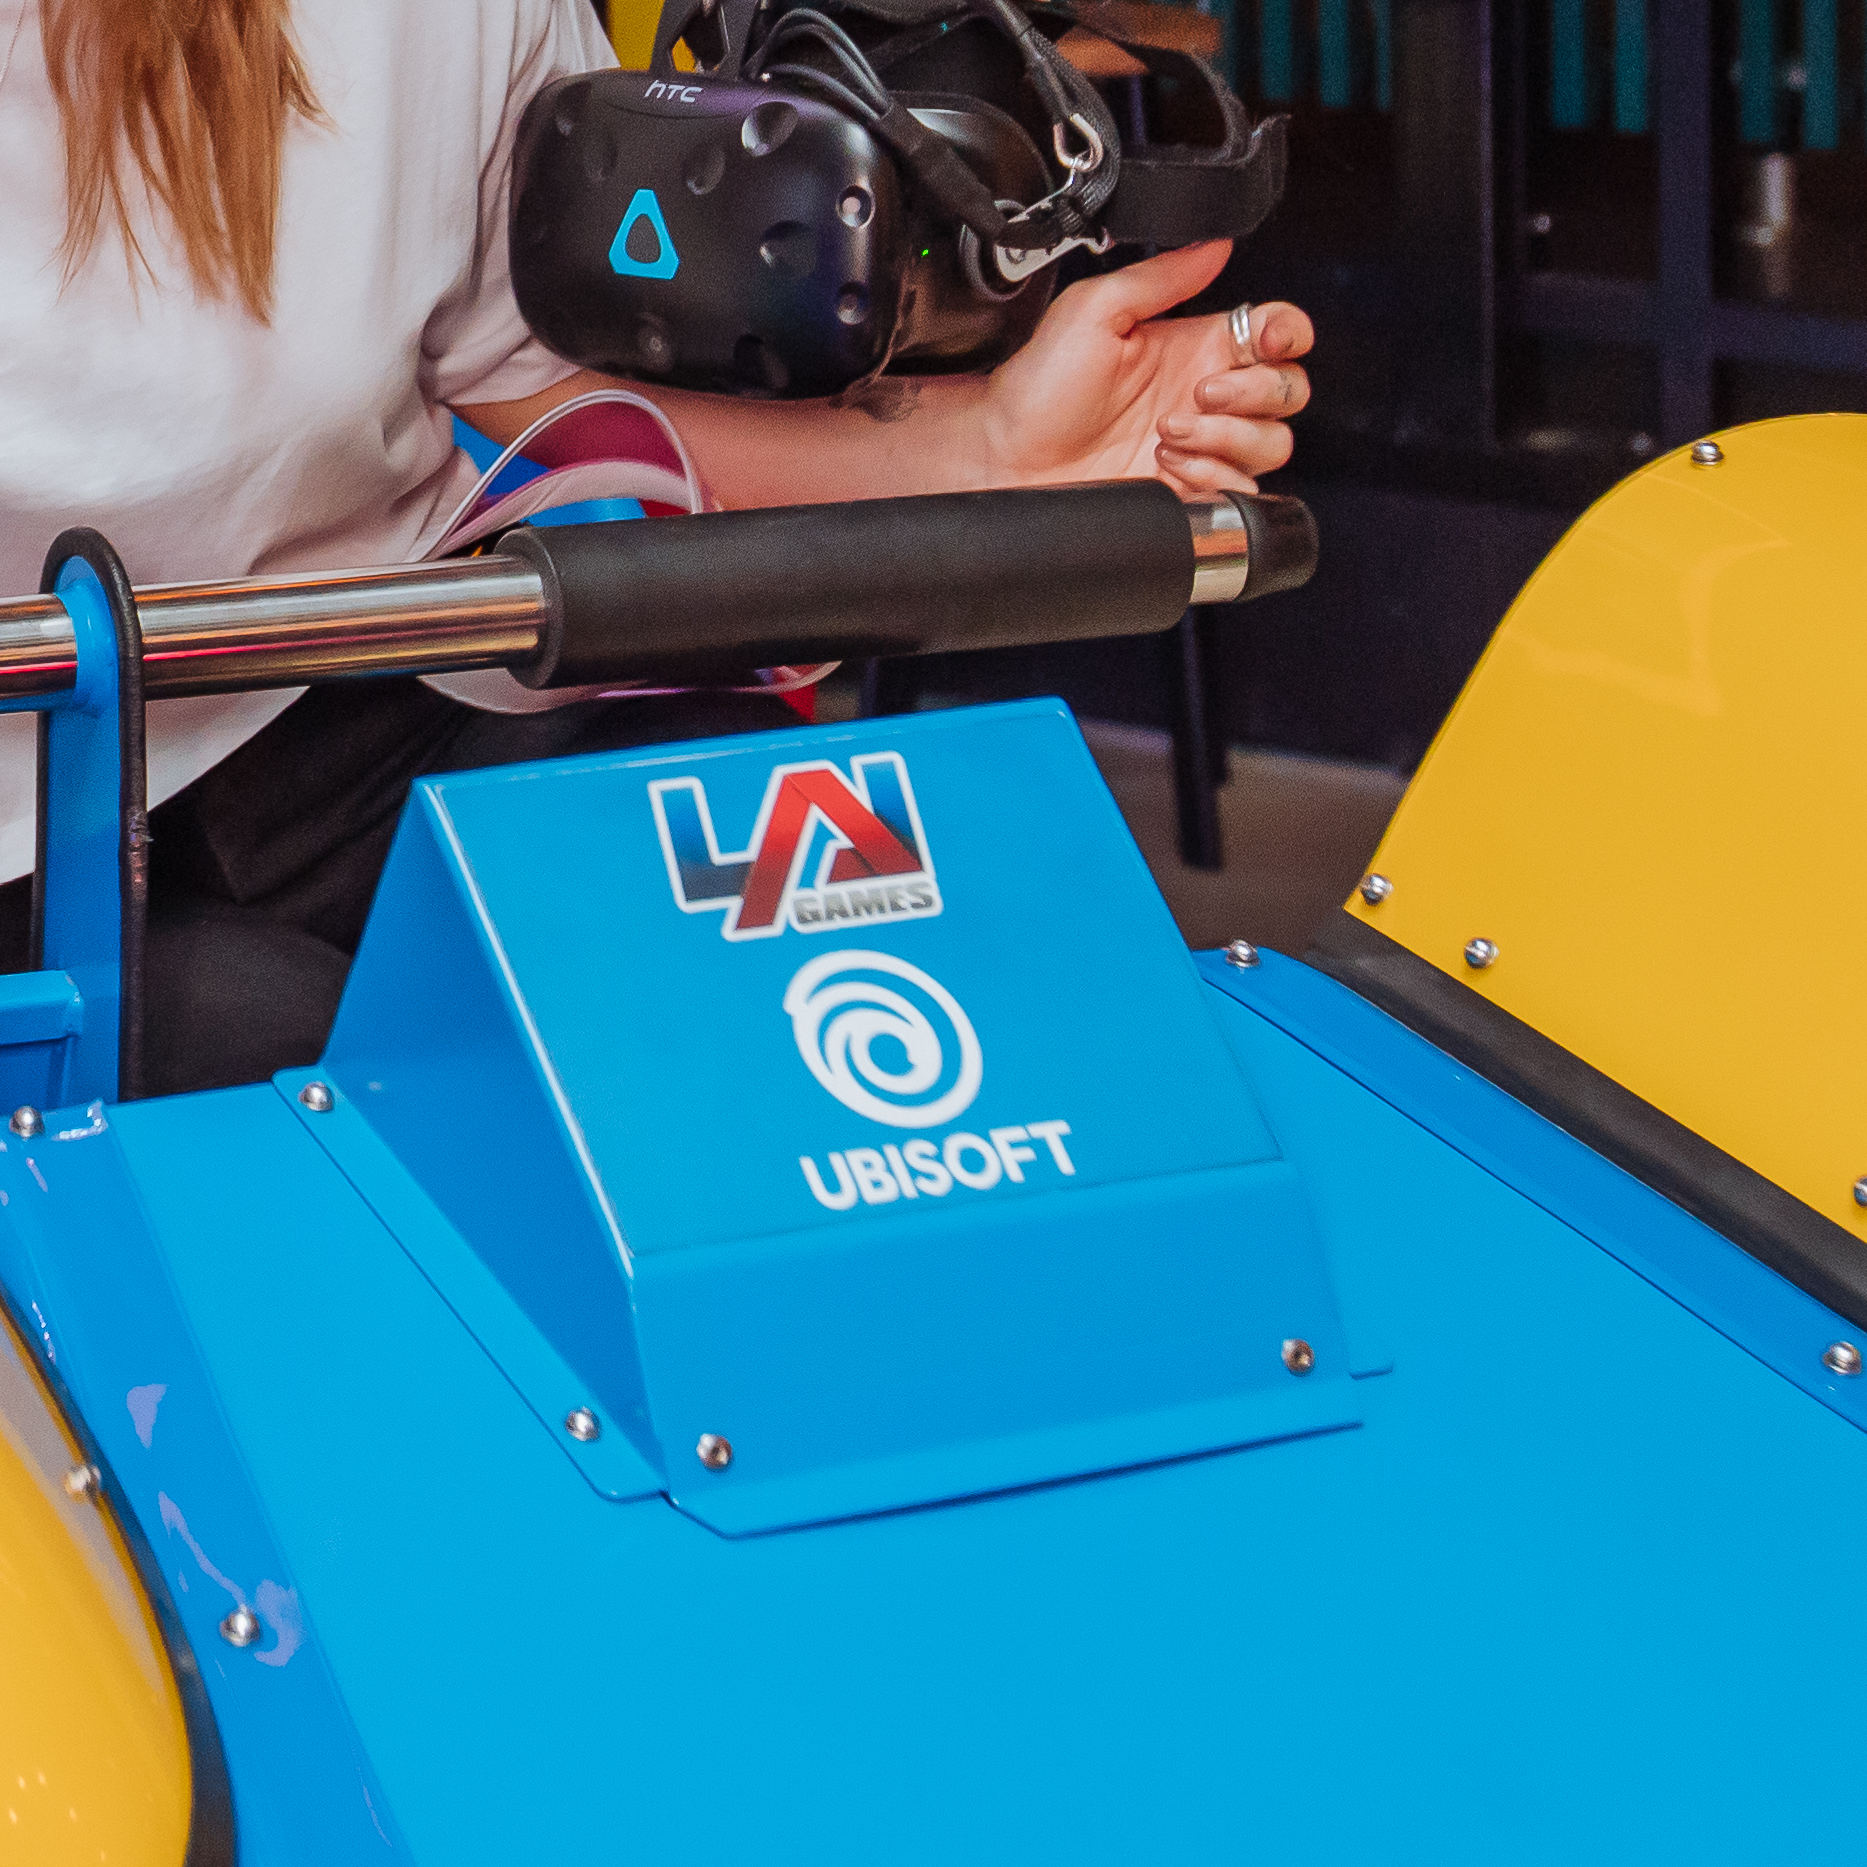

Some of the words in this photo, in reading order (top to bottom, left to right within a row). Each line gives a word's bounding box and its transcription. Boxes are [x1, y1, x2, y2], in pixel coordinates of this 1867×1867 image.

[648, 751, 935, 941] LAI
[793, 881, 934, 924] GAMES
[800, 1120, 1075, 1210] UBISOFT
